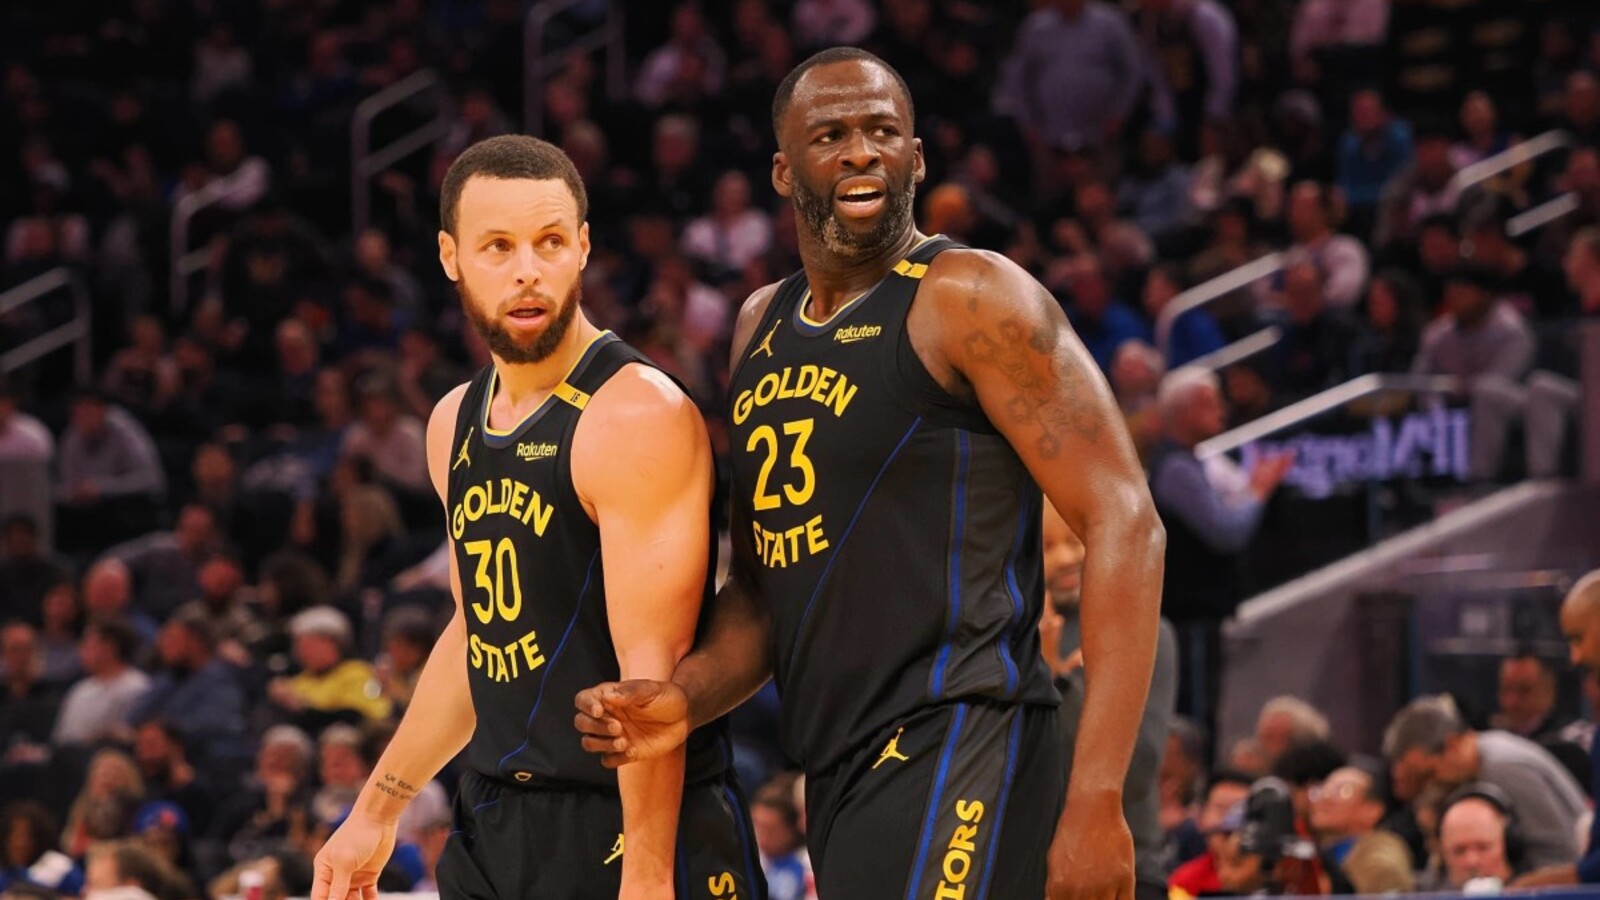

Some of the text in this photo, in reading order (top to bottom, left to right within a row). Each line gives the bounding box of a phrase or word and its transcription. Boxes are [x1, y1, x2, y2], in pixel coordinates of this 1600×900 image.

[833, 324, 882, 344] Rakuten
[732, 364, 858, 426] GOLDEN
[516, 441, 558, 461] Rakuten
[746, 417, 817, 511] 23
[452, 477, 555, 540] GOLDEN
[752, 514, 830, 568] STATE
[463, 537, 522, 625] 30
[469, 630, 546, 683] STATE
